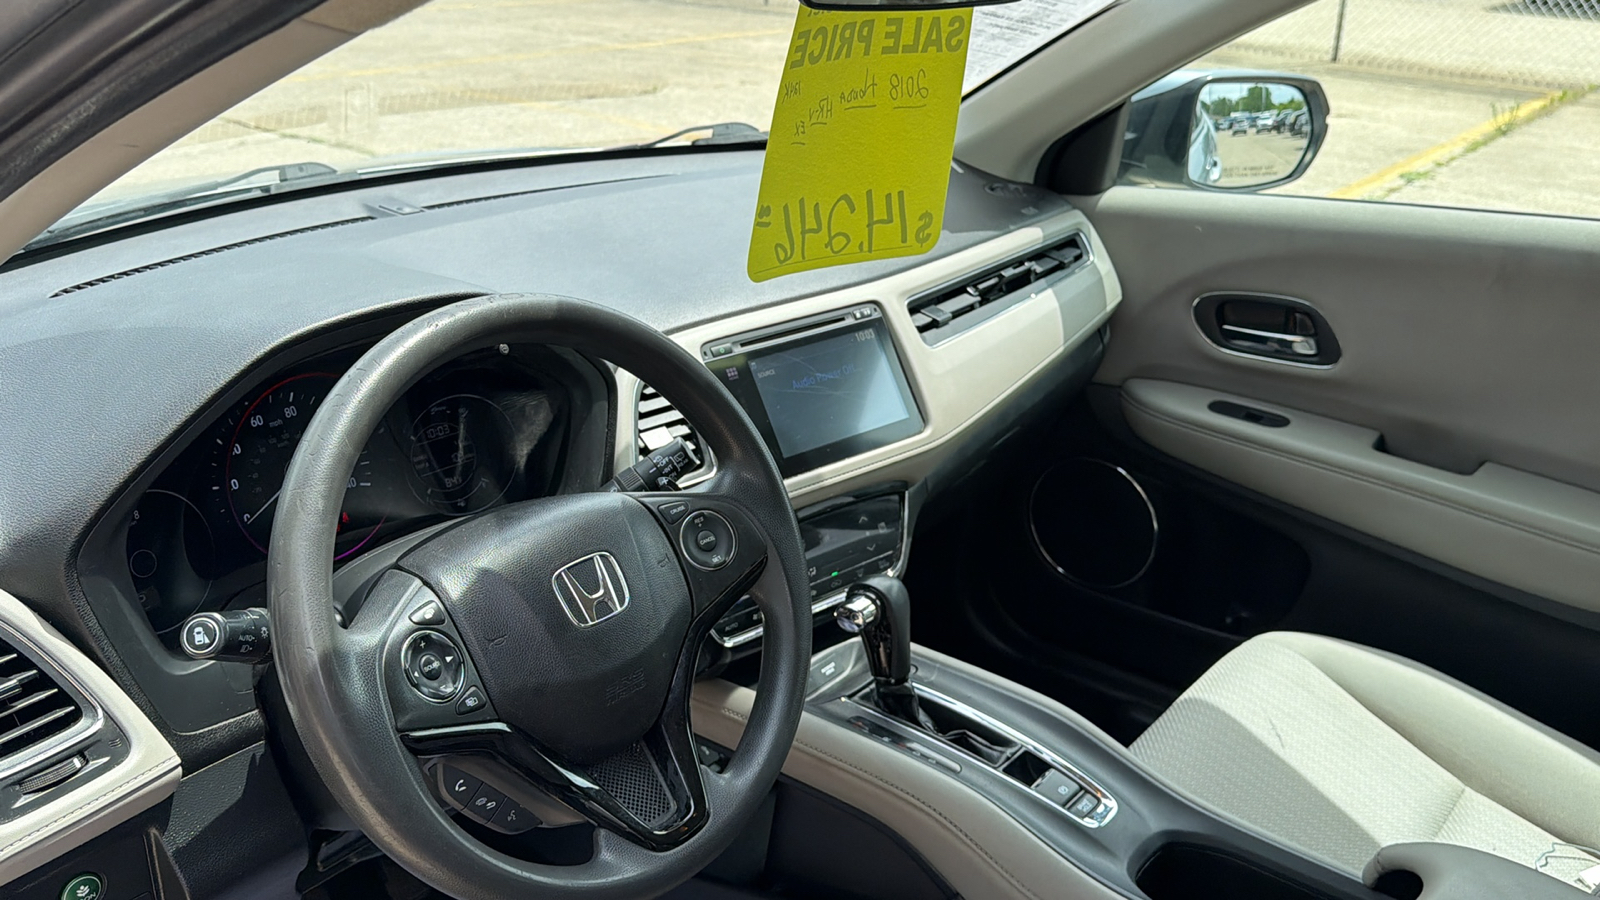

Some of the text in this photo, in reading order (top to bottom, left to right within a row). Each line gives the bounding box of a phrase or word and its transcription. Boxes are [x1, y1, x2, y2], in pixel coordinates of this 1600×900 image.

[855, 330, 875, 342] 10:03
[792, 375, 815, 390] Audio
[815, 368, 841, 383] Power
[283, 405, 298, 418] 80
[250, 415, 264, 428] 60
[426, 424, 450, 438] 10:03
[669, 505, 685, 515] CRUISE
[699, 535, 716, 546] CANCEL
